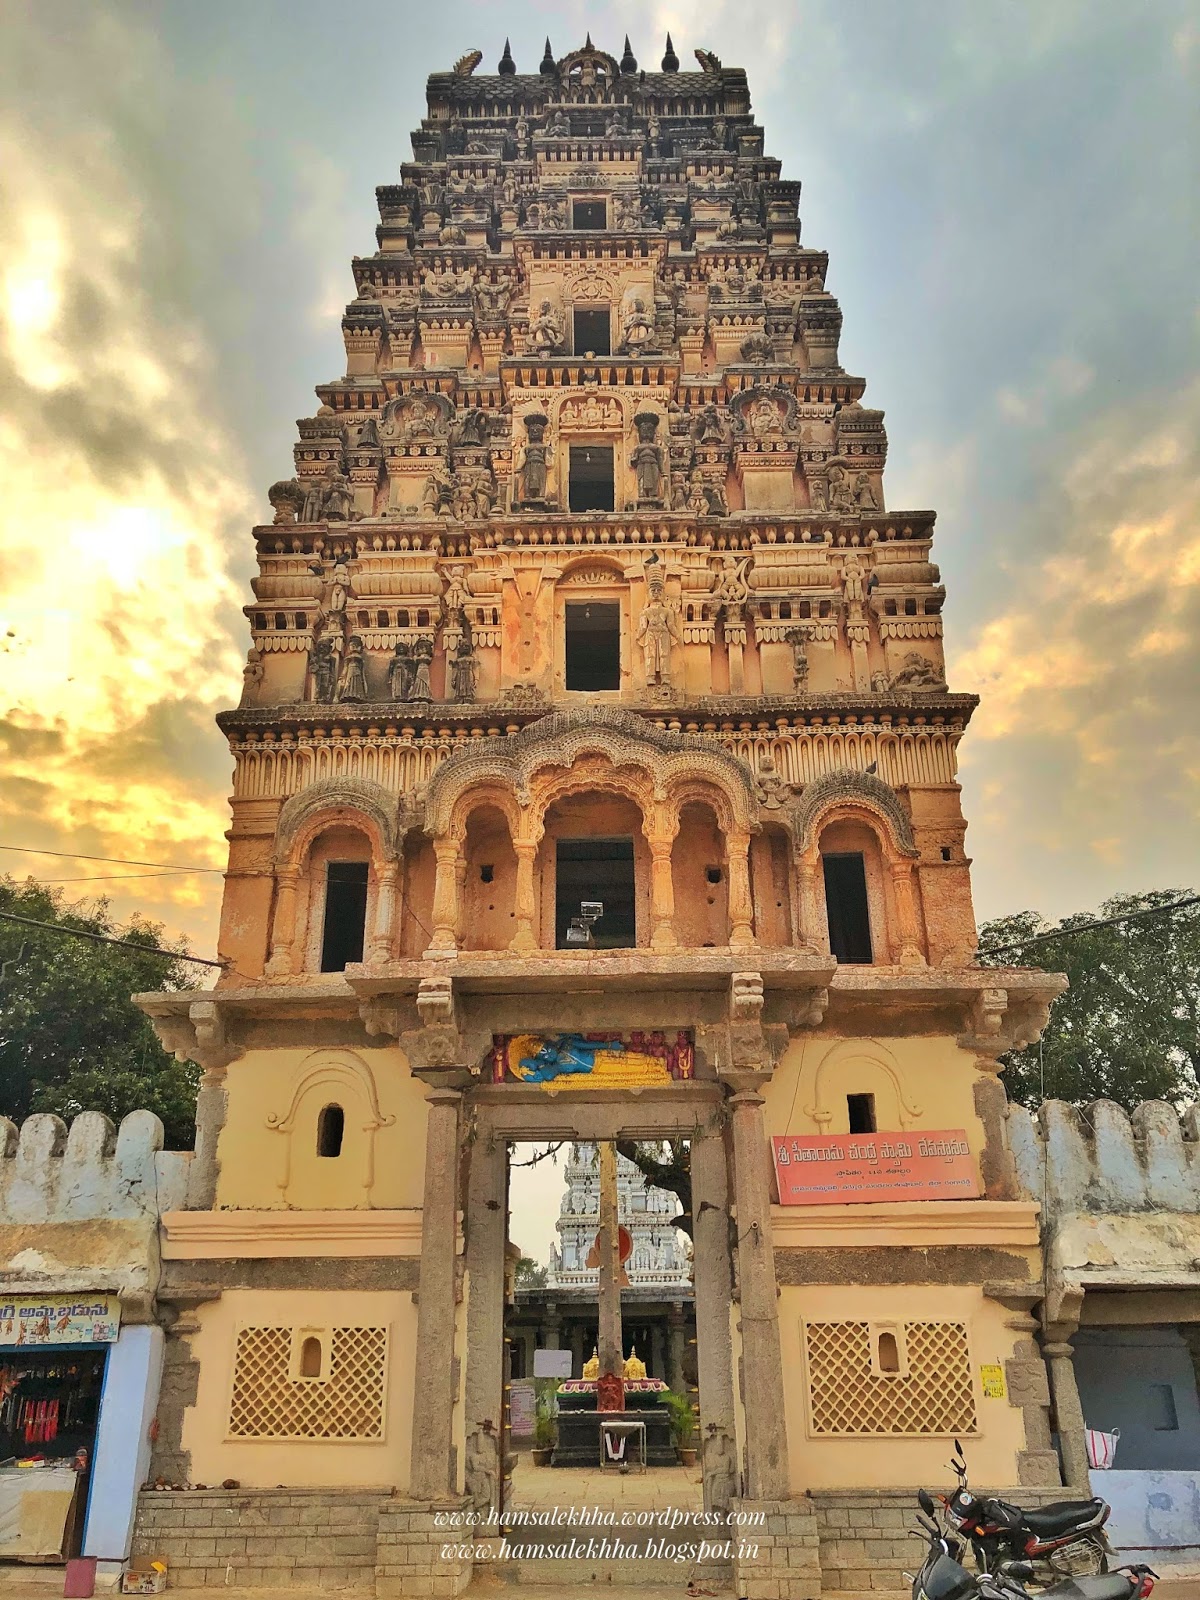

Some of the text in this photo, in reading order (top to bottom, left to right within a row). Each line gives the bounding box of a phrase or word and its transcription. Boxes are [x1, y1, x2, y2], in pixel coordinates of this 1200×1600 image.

[793, 1140, 845, 1162] సీతారామ
[849, 1141, 878, 1166] చంద్ర
[880, 1142, 912, 1166] స్వామి
